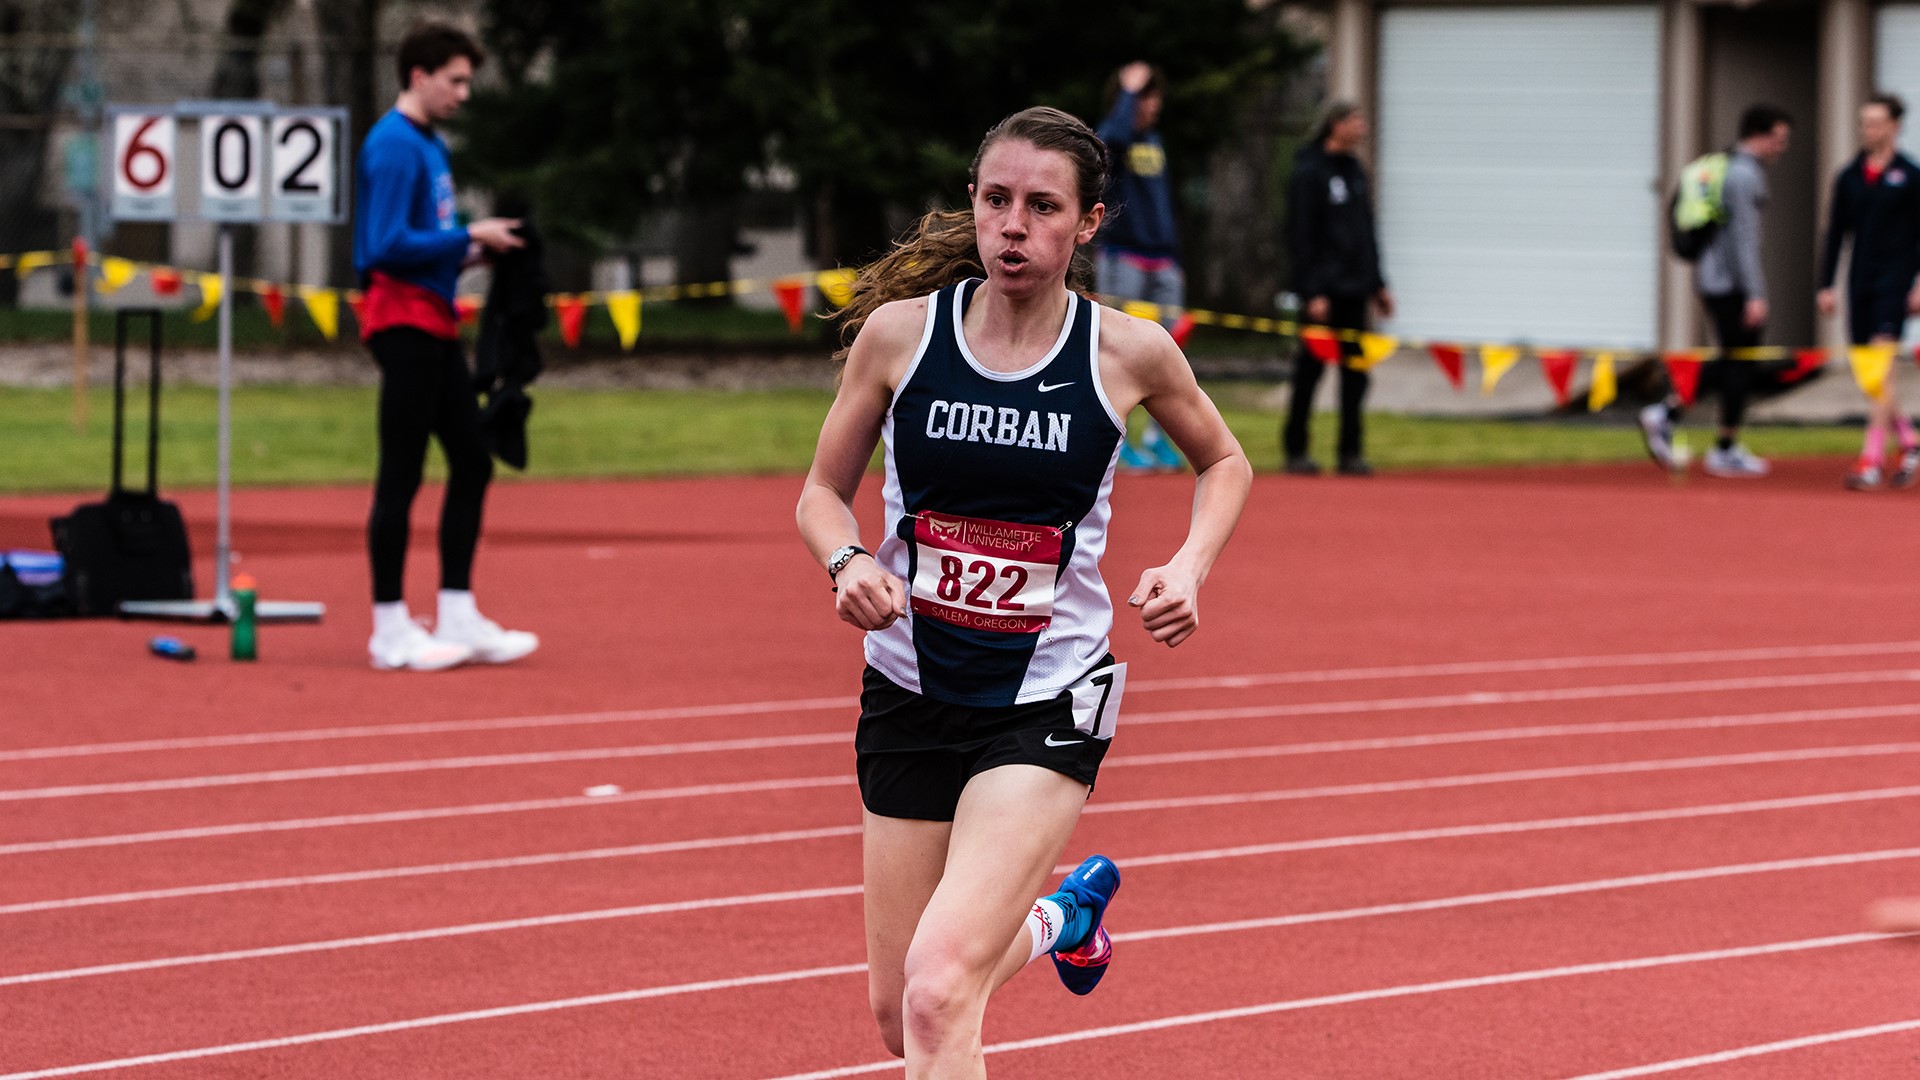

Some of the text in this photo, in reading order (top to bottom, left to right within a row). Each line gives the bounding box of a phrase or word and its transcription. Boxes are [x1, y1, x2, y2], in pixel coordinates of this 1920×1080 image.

[926, 400, 1072, 452] CORBAN
[967, 534, 1034, 552] UNIVERSITY
[968, 523, 1042, 543] WILLAMETTE
[936, 555, 1029, 612] 822
[931, 607, 1028, 630] SALEM, OREGON
[1090, 672, 1114, 737] 7
